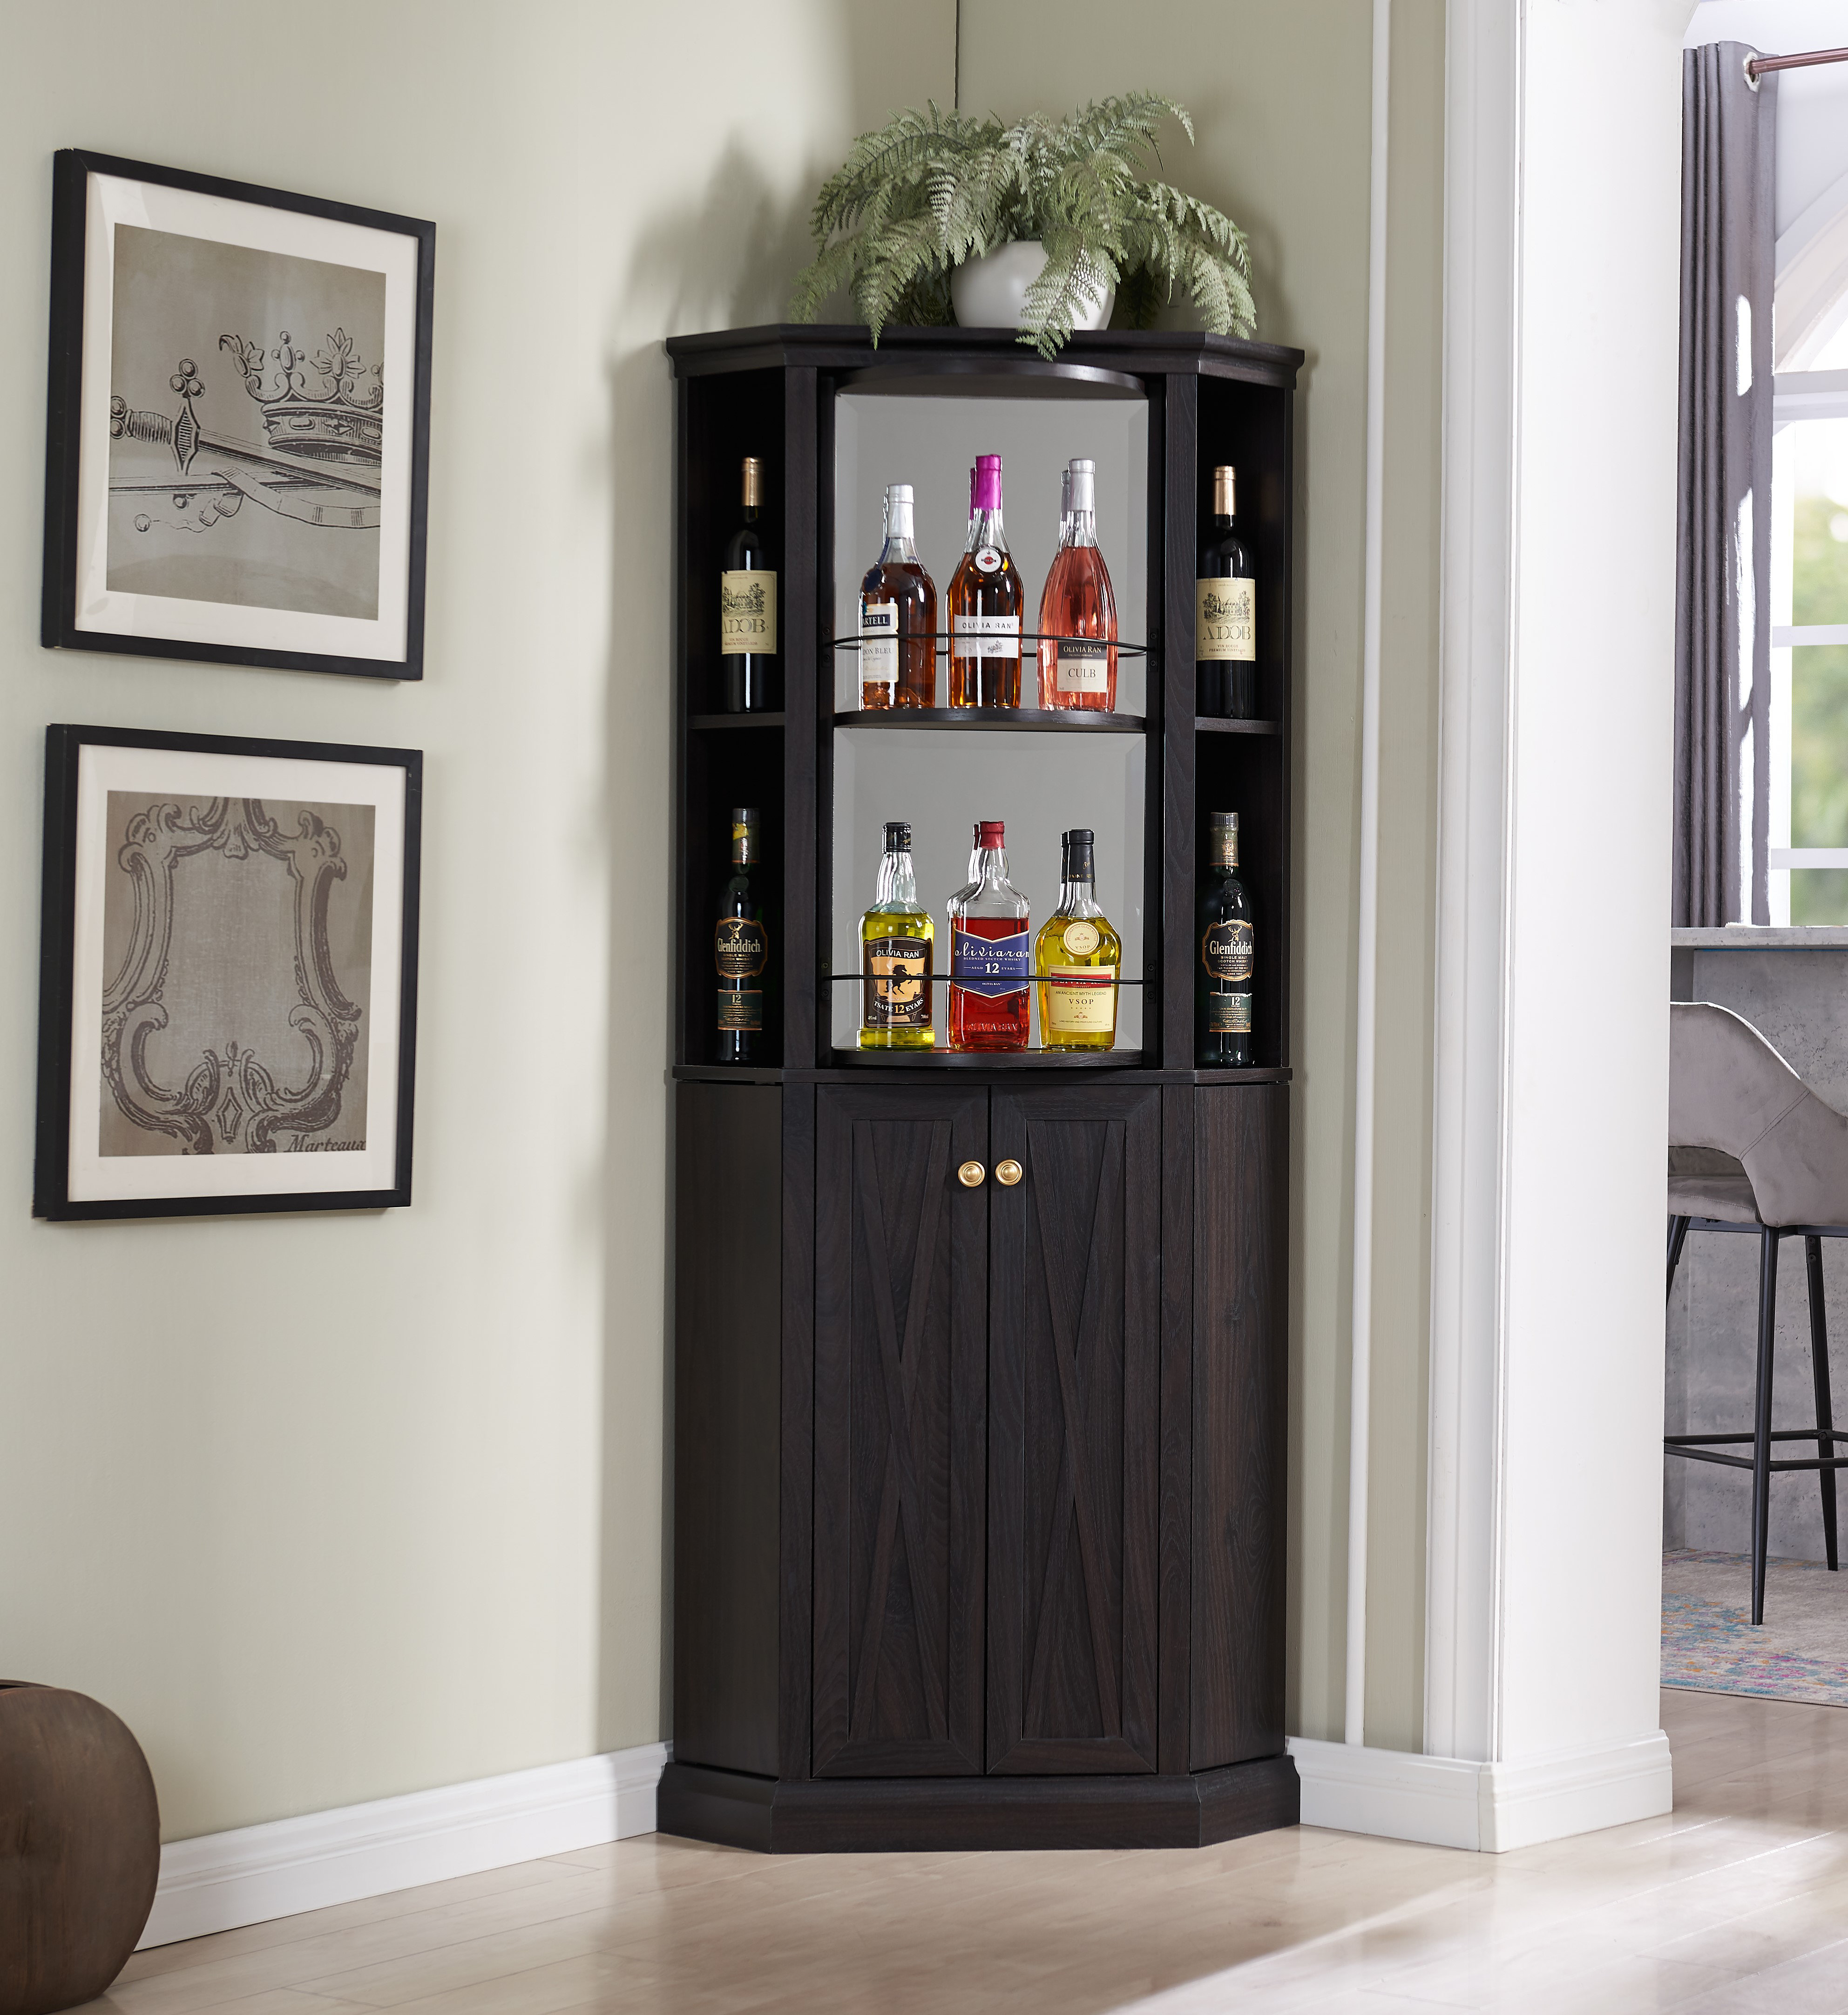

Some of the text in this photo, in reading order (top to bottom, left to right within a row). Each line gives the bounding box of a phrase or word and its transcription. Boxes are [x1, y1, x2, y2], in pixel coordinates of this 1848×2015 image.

[1068, 667, 1096, 678] CULB
[718, 938, 761, 952] Glenfiddich
[1209, 940, 1252, 955] Glenfiddich
[985, 963, 1000, 973] 12
[731, 994, 742, 1003] 12
[1231, 997, 1240, 1005] 12
[873, 997, 924, 1013] TSATE 12 EYARS
